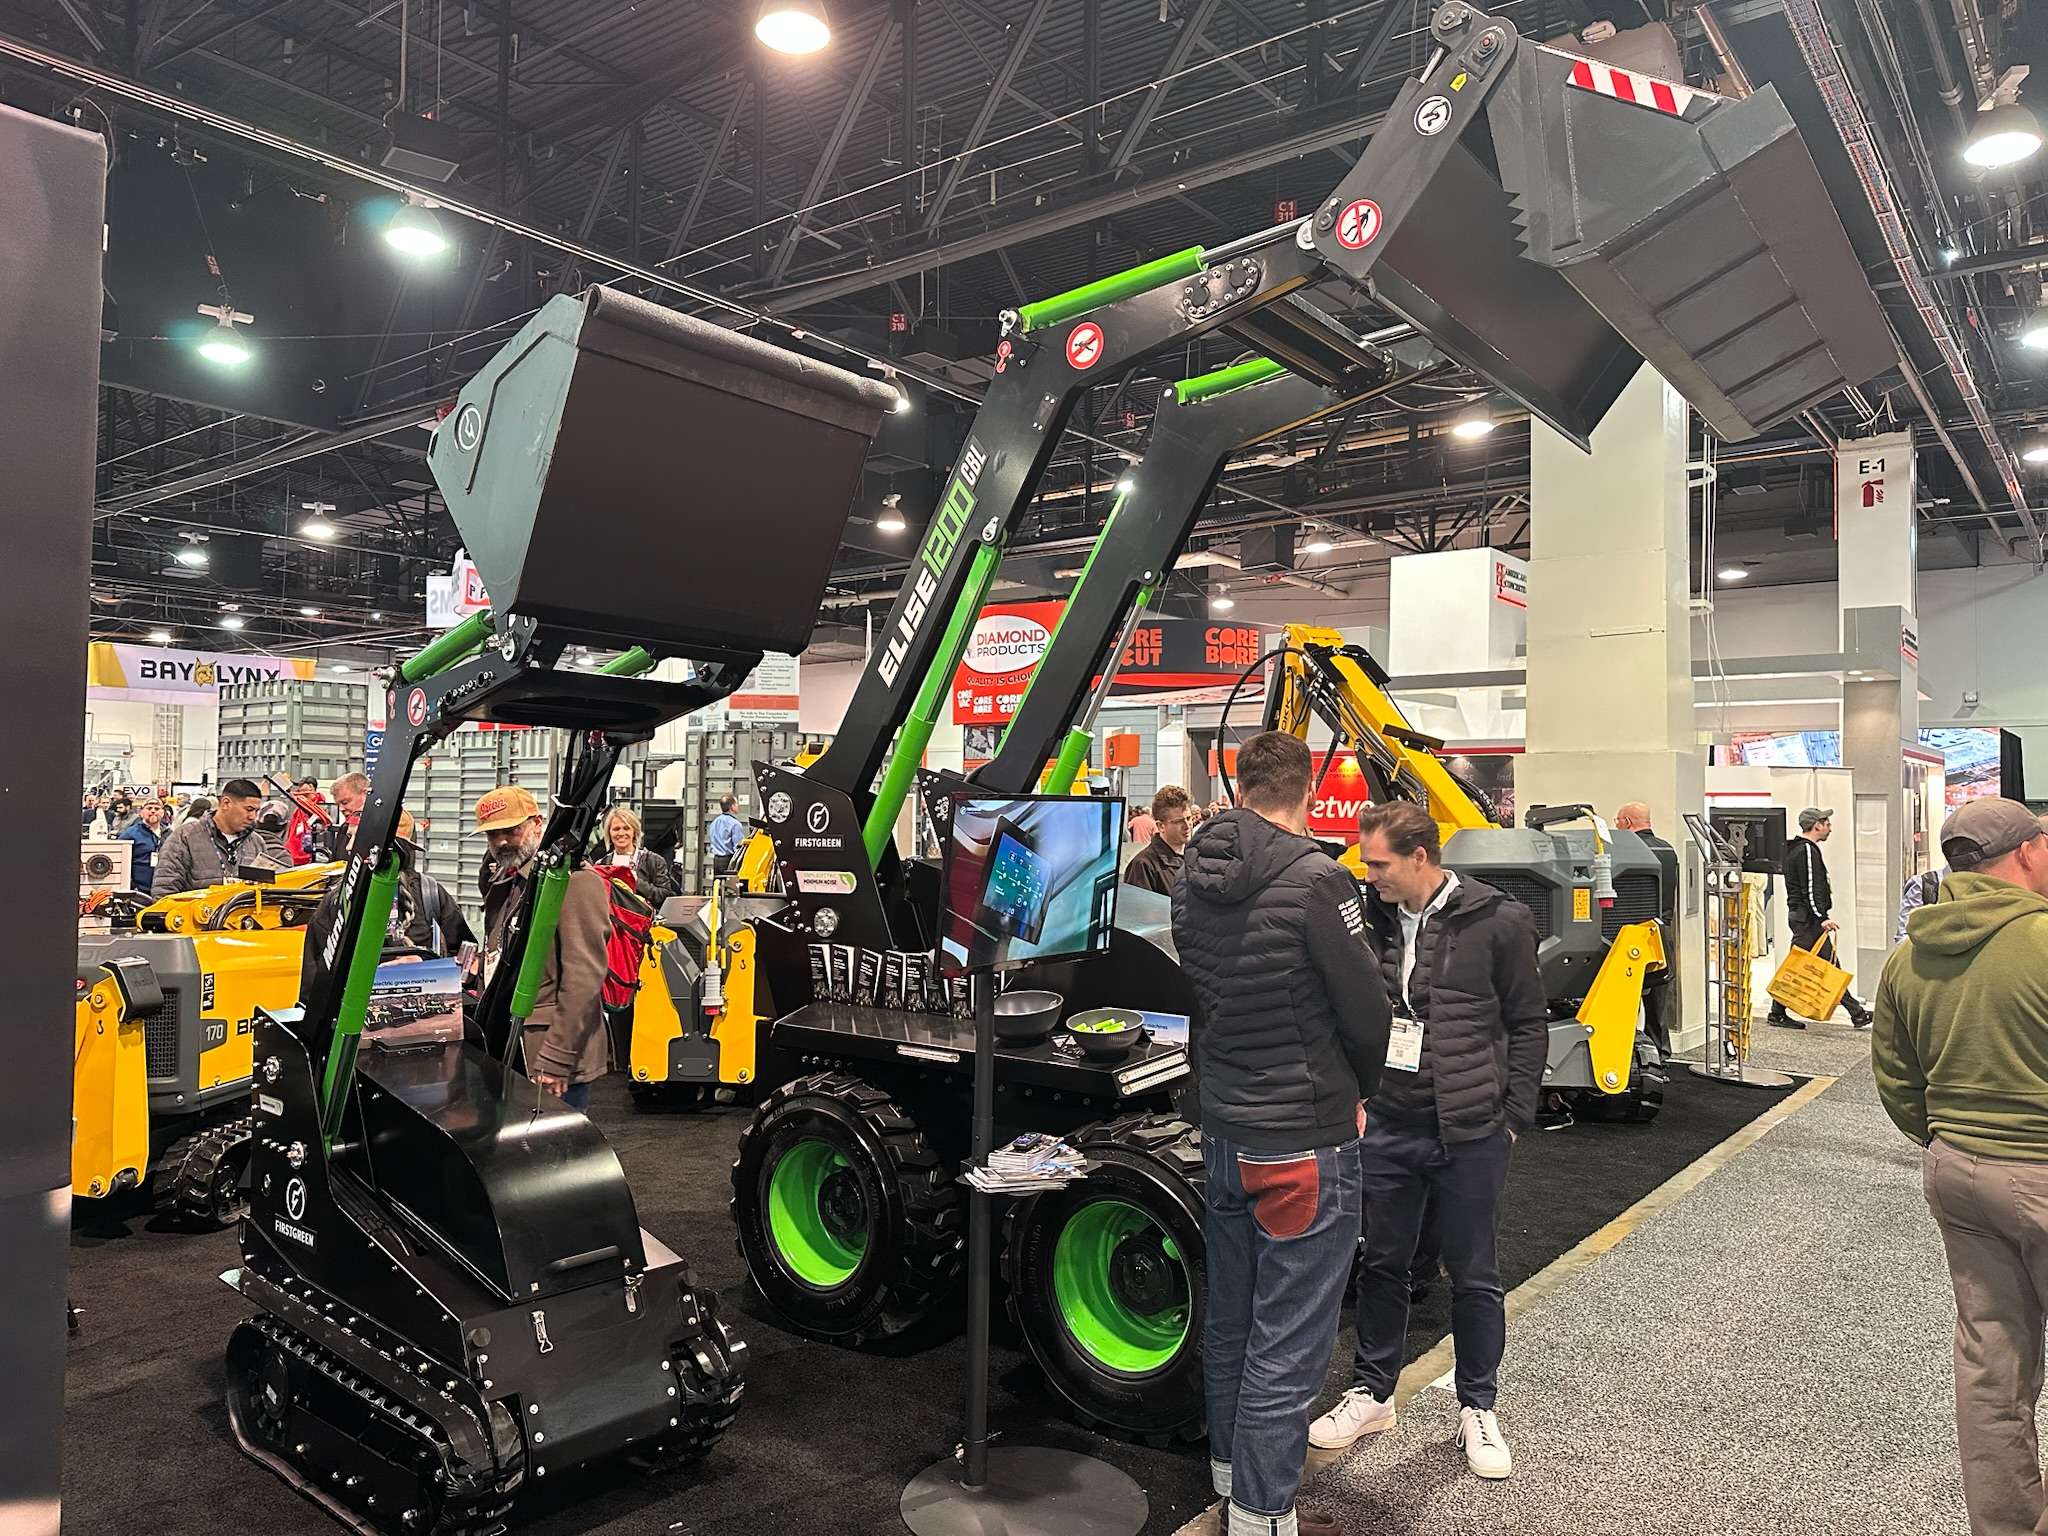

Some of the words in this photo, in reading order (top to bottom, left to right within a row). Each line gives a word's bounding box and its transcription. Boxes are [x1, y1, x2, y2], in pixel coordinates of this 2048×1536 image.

[1277, 211, 1294, 222] 311
[891, 322, 905, 331] 310
[1859, 458, 1885, 475] E-1
[877, 567, 937, 689] ELISE
[921, 477, 976, 579] 1200
[960, 443, 987, 487] CBL
[976, 629, 1046, 646] DIAMOND
[1110, 628, 1162, 648] ORE
[1204, 627, 1260, 648] CORE
[976, 643, 1046, 658] PRODUCTS
[1204, 646, 1259, 667] BORE
[140, 659, 194, 681] BAY
[216, 665, 281, 684] LYNX
[966, 675, 994, 686] QUALITY
[996, 677, 1006, 685] IS
[957, 689, 973, 699] CORE
[973, 695, 993, 705] CORE
[995, 693, 1023, 705] CORE
[958, 698, 971, 708] VAC
[972, 704, 993, 714] BORE
[123, 786, 151, 796] EVO
[794, 837, 842, 848] FIRSTGREEN
[322, 909, 345, 971] Mini
[394, 979, 410, 987] green
[410, 977, 437, 985] machines
[1146, 1022, 1168, 1030] machines
[205, 1023, 224, 1042] 170
[274, 1218, 315, 1248] FIRSTGREEN
